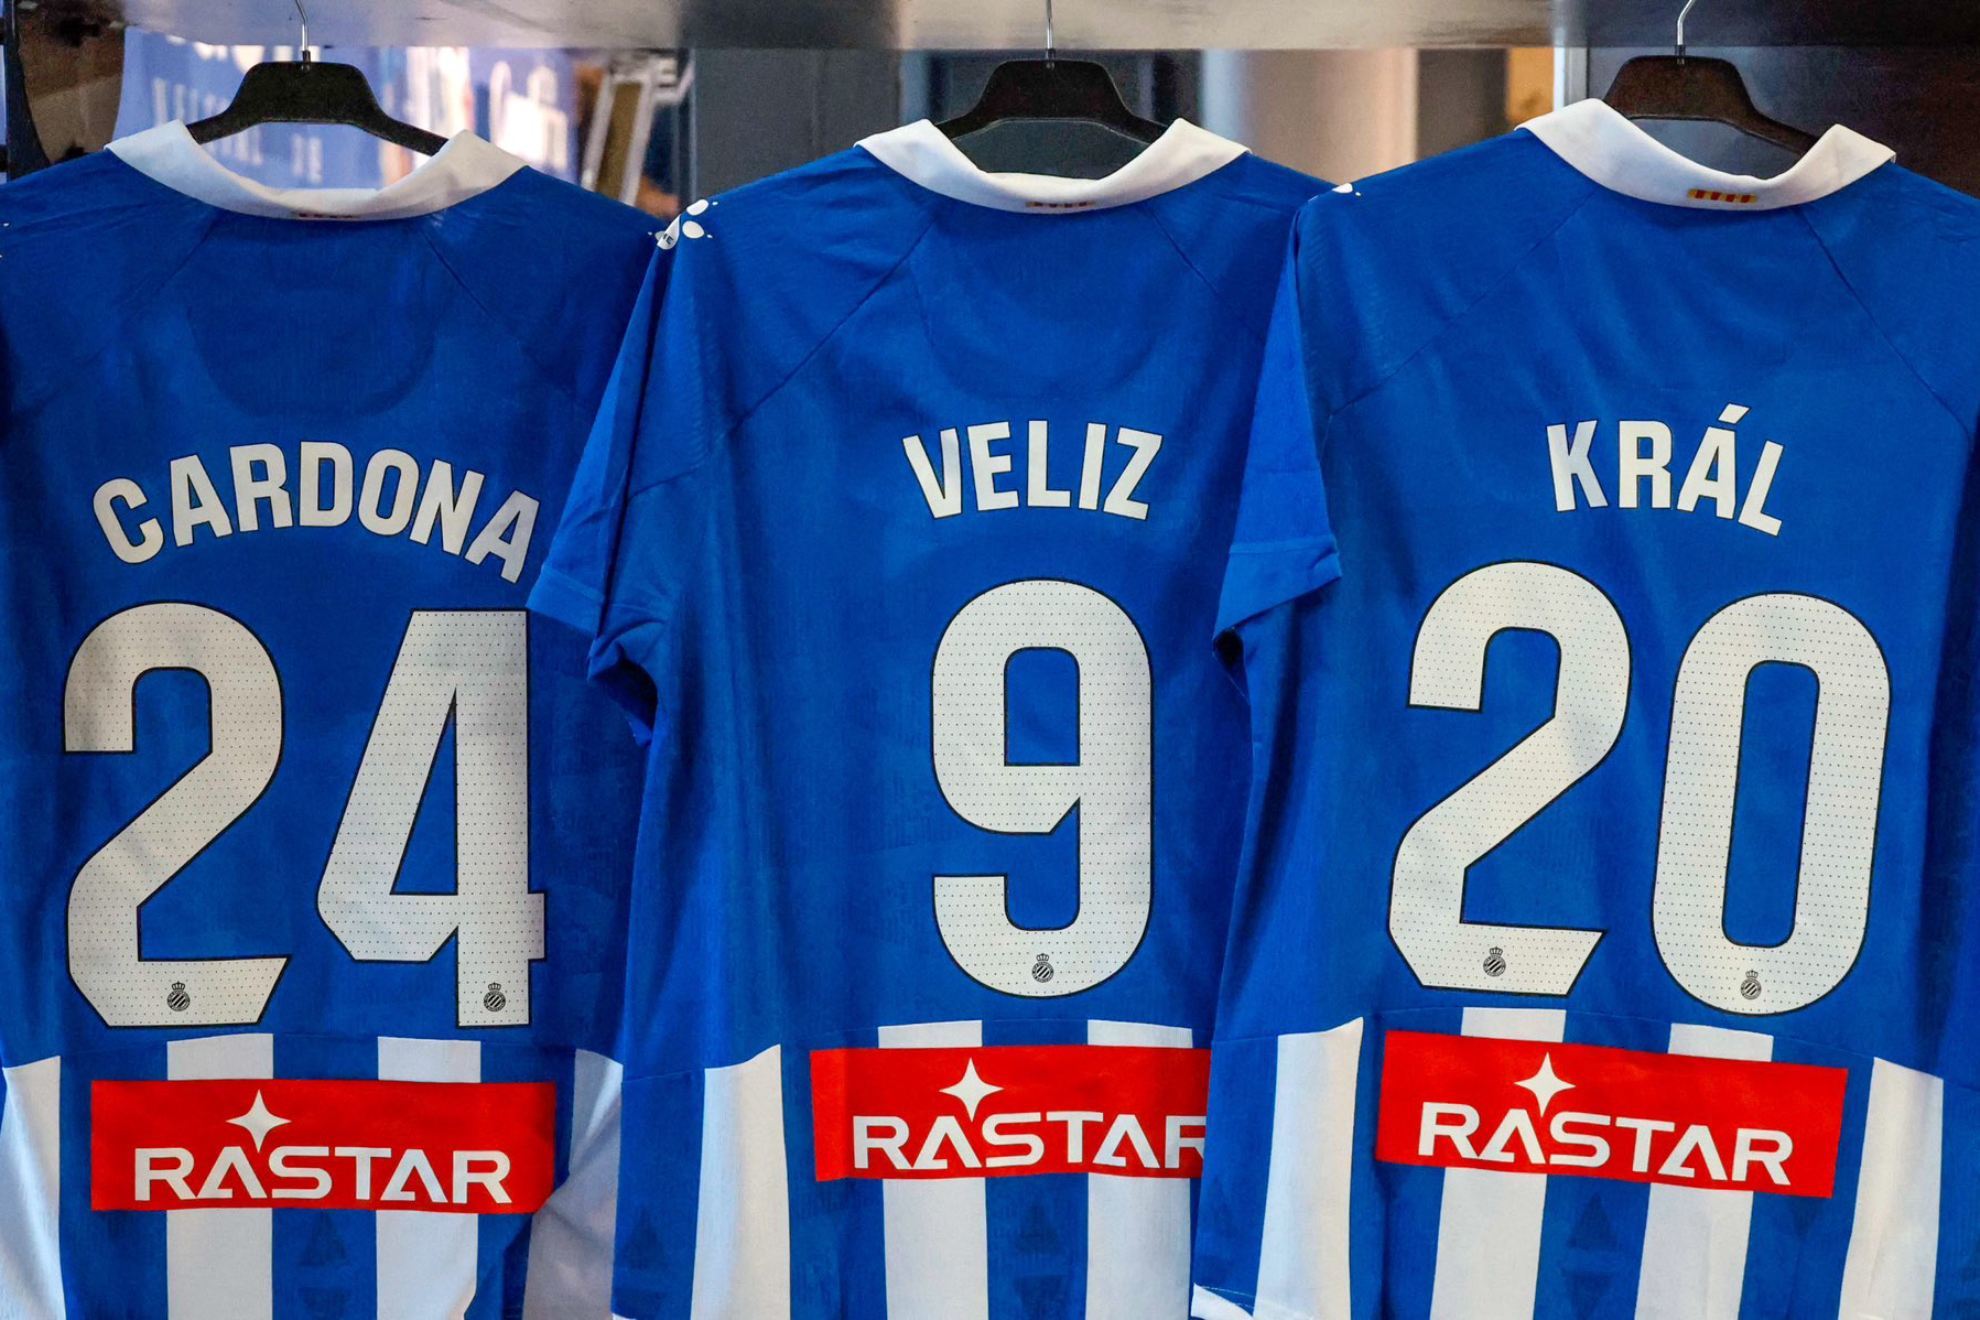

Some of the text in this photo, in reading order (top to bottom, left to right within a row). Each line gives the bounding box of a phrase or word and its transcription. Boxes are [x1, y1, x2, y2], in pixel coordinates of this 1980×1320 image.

[93, 441, 540, 584] CARDONA
[901, 419, 1163, 521] VELIZ
[1546, 402, 1785, 537] KRÁL
[63, 601, 546, 1028] 24
[930, 578, 1153, 999] 9
[1387, 560, 1892, 1016] 20
[134, 1145, 514, 1204] RASTAR
[1418, 1101, 1795, 1186] RASTAR
